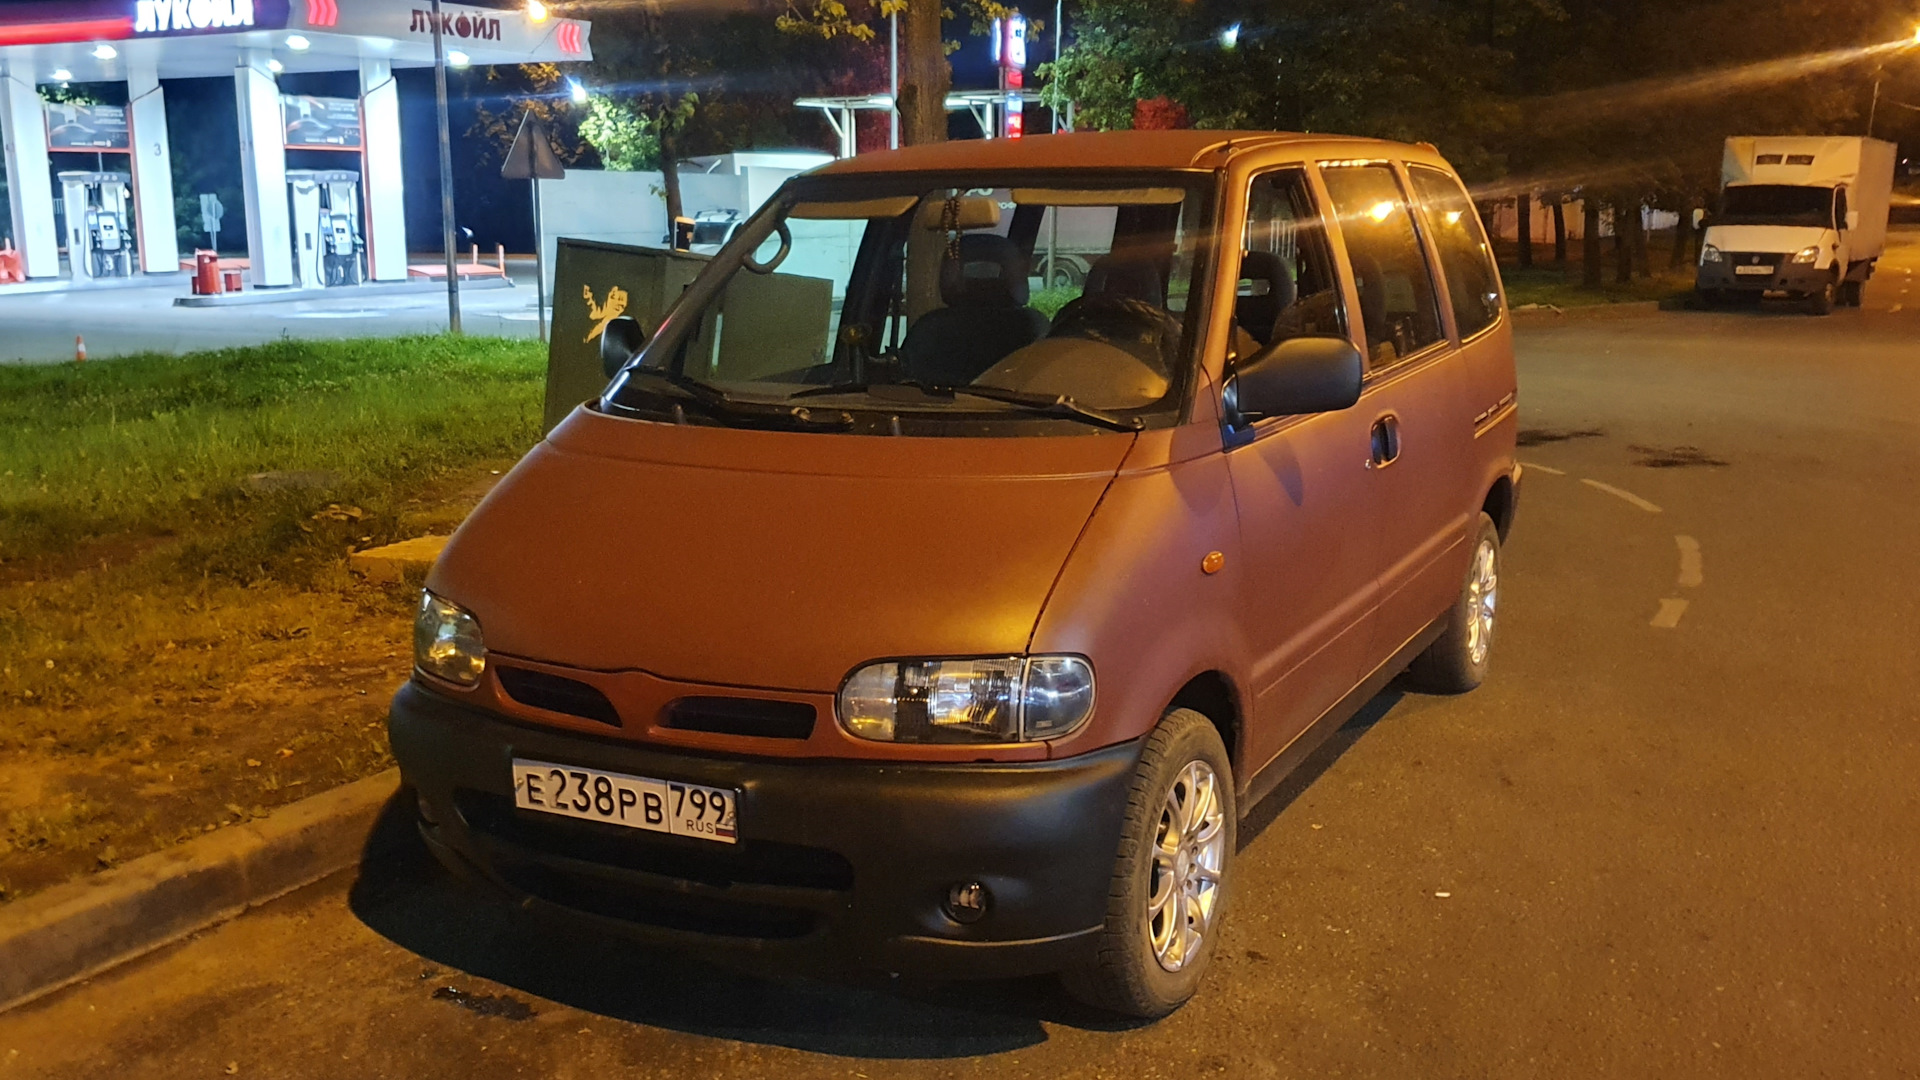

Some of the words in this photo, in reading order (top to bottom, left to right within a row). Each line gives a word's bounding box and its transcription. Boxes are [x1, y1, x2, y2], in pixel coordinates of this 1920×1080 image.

[154, 143, 162, 156] 3
[670, 785, 726, 823] 799
[686, 819, 715, 835] RUS
